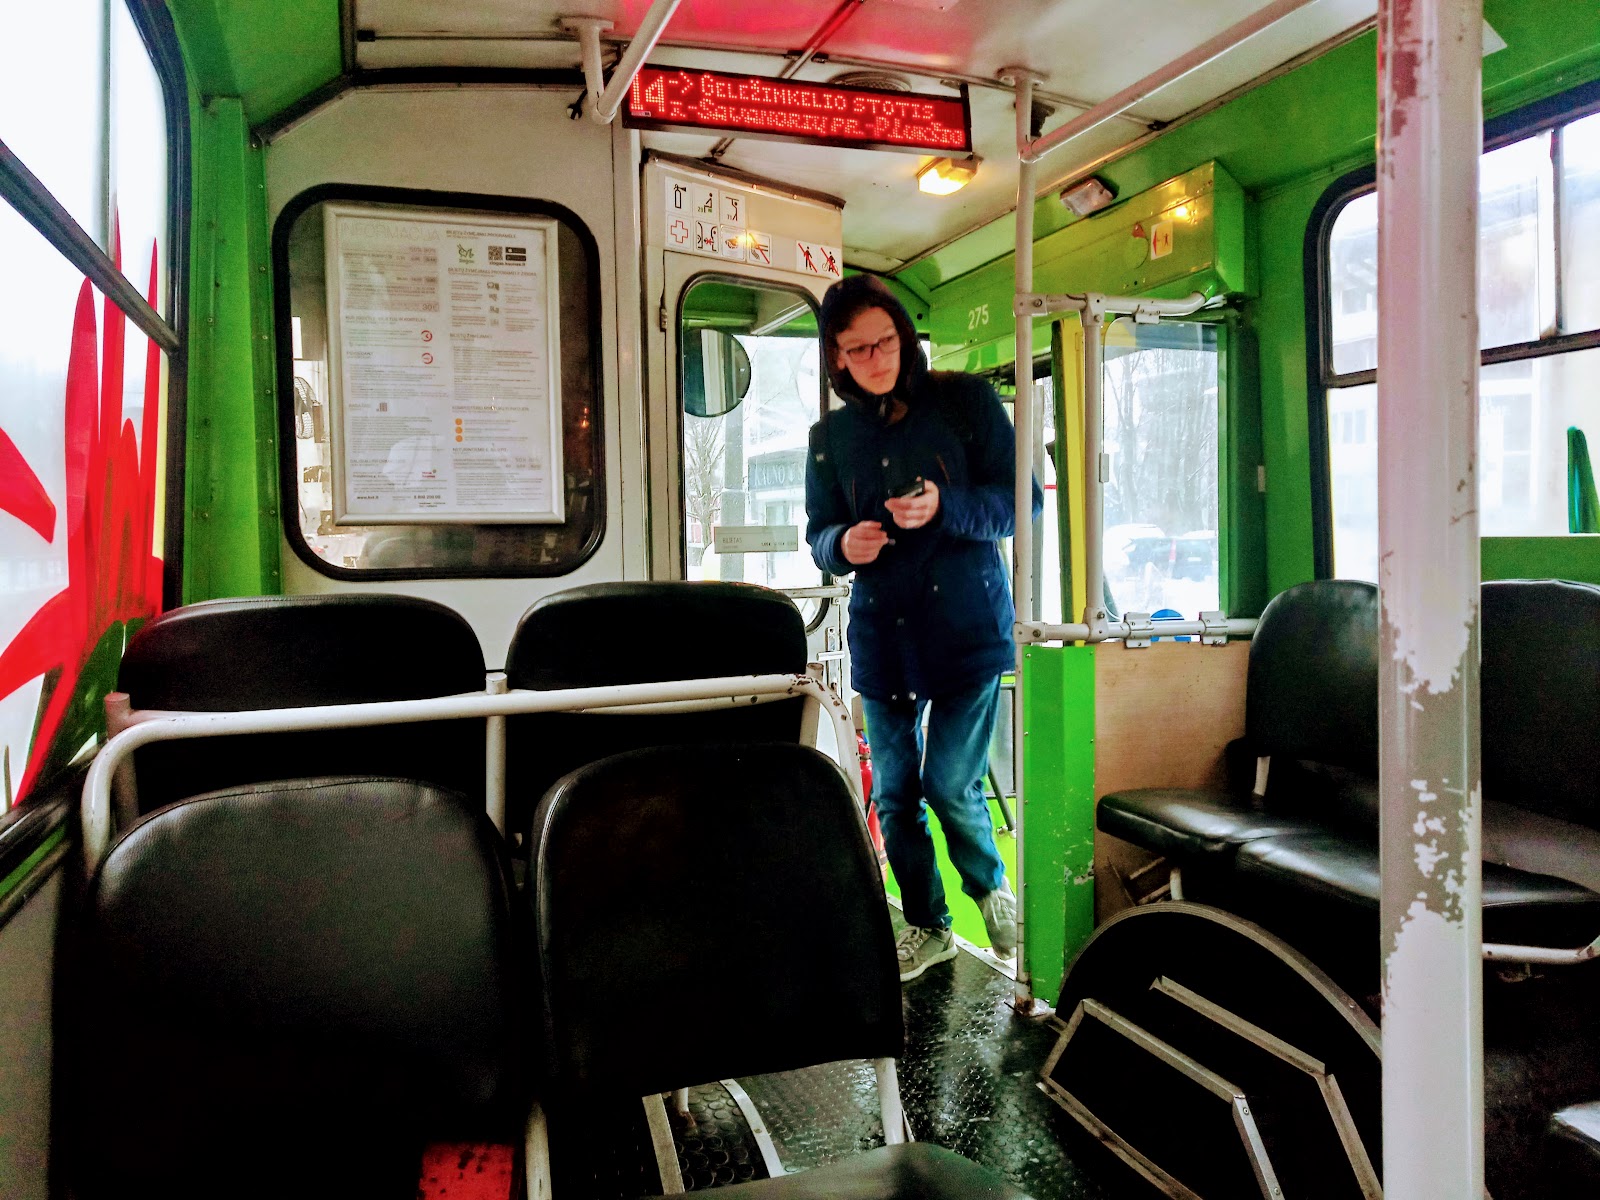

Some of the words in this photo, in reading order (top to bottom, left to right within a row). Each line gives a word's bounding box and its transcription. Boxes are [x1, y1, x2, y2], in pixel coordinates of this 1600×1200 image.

[631, 73, 665, 112] 14
[853, 97, 934, 119] STOTIS
[968, 303, 989, 330] 275
